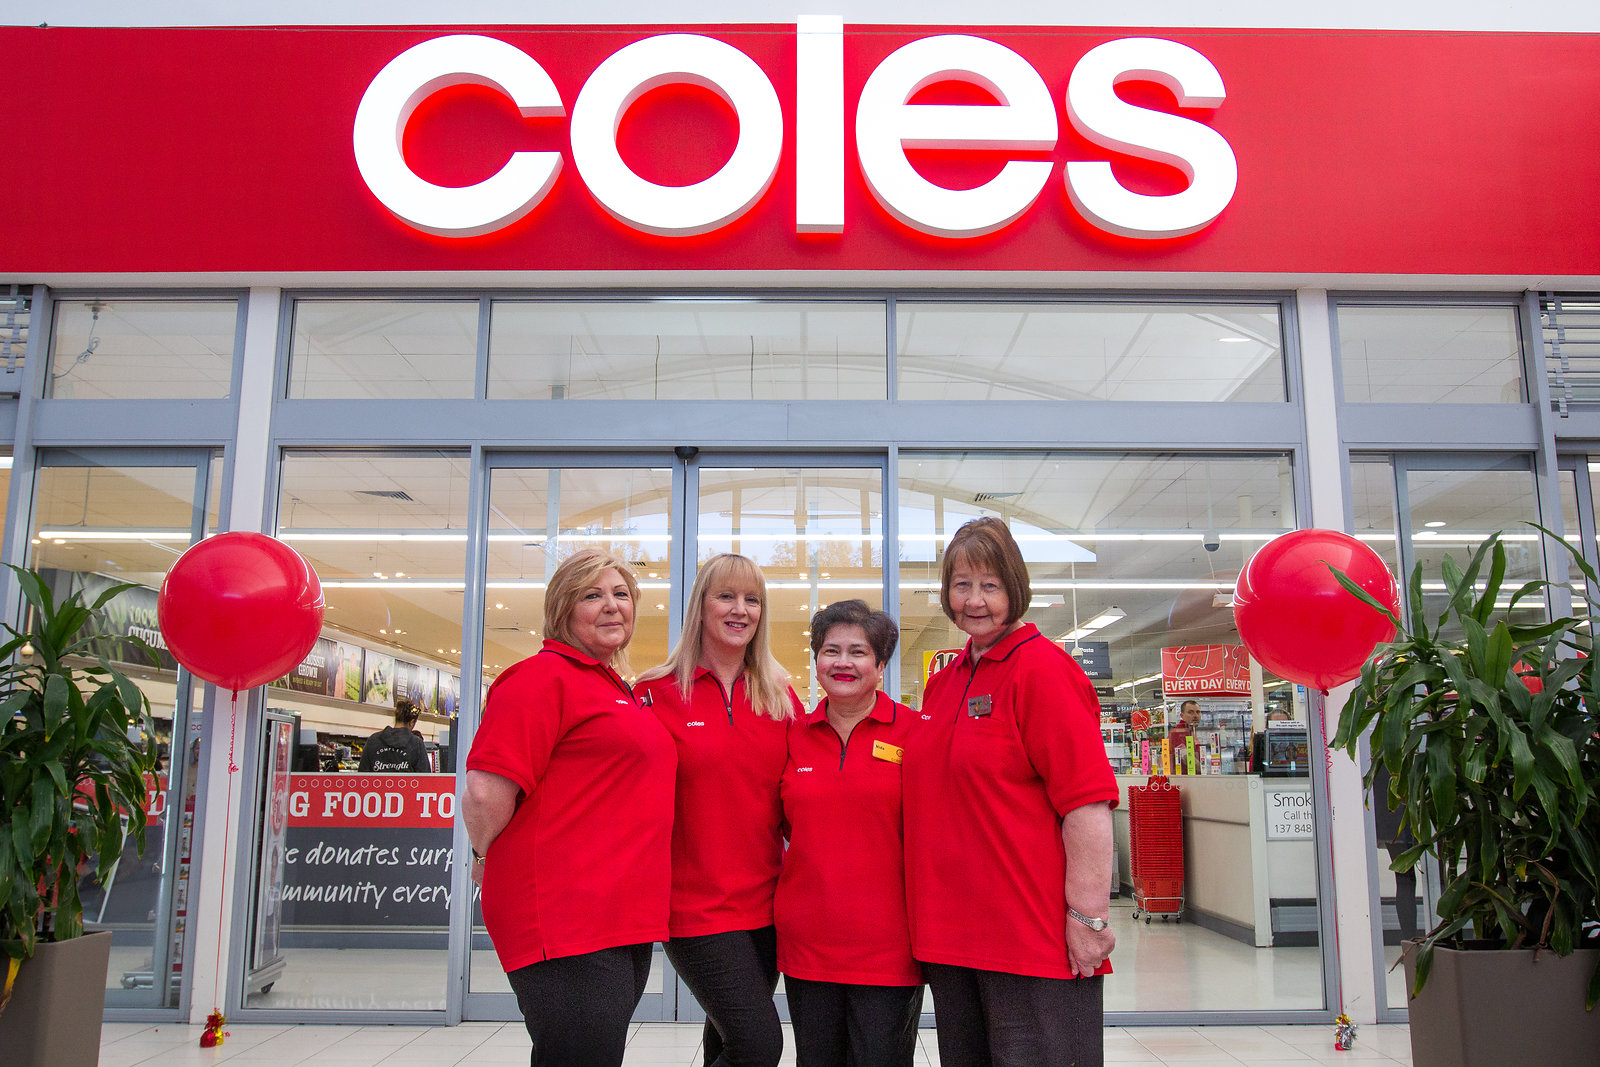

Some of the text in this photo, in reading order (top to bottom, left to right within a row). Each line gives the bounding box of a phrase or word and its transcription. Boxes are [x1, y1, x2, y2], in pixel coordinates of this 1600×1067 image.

[352, 14, 1239, 239] coles
[1164, 678, 1223, 692] EVERY DAY
[1226, 679, 1247, 690] EVERY
[376, 746, 407, 757] COMPLETE
[373, 760, 409, 772] Strength
[321, 791, 405, 818] FOOD
[416, 792, 456, 819] TO
[1273, 792, 1312, 807] Smok
[1283, 810, 1301, 821] Call
[1274, 824, 1313, 833] 137 848
[305, 841, 400, 866] donates
[392, 883, 453, 910] every
